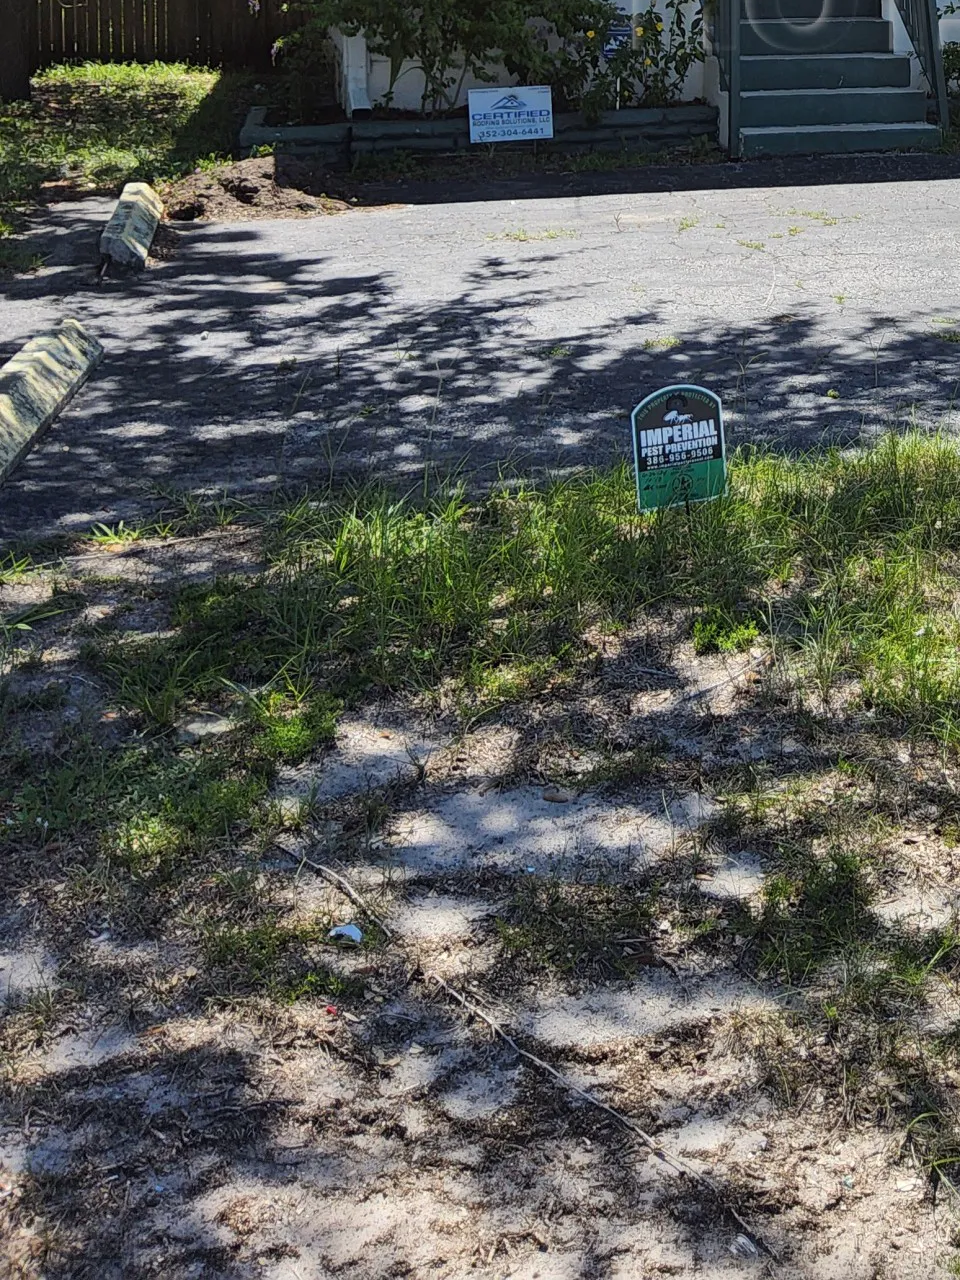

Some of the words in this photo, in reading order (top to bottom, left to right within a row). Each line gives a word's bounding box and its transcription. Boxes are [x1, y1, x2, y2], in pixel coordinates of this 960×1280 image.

[471, 109, 551, 120] CERTIFIED
[538, 116, 551, 124] LLC
[640, 419, 718, 447] IMPERIAL
[641, 445, 663, 458] PEST
[665, 435, 718, 454] PREVENTION
[646, 447, 714, 466] 386-956-9506
